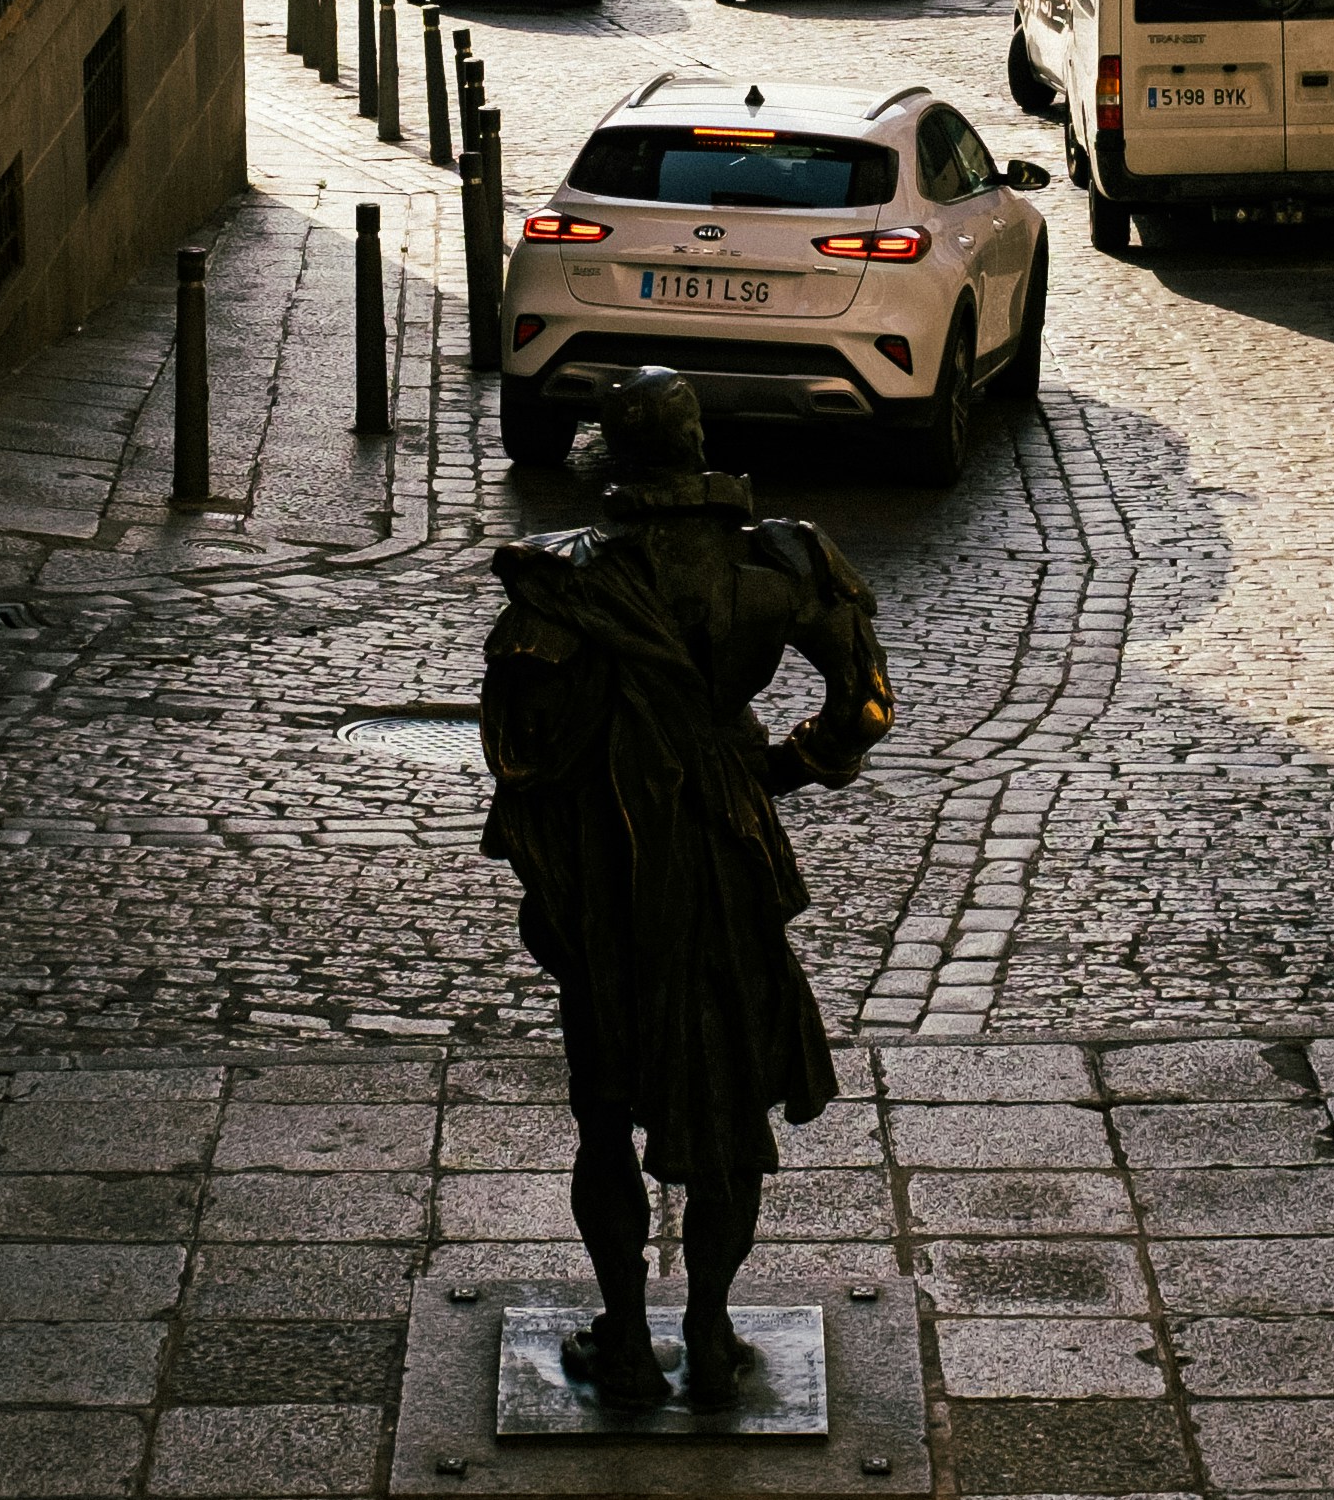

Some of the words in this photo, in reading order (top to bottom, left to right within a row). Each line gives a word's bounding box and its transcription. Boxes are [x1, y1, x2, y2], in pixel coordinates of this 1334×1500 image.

[1147, 33, 1207, 45] TRANSIT
[1161, 88, 1205, 106] 5198
[1213, 88, 1247, 106] BYK
[698, 227, 721, 238] KIA
[660, 275, 713, 300] 1161
[723, 278, 769, 304] LSG
